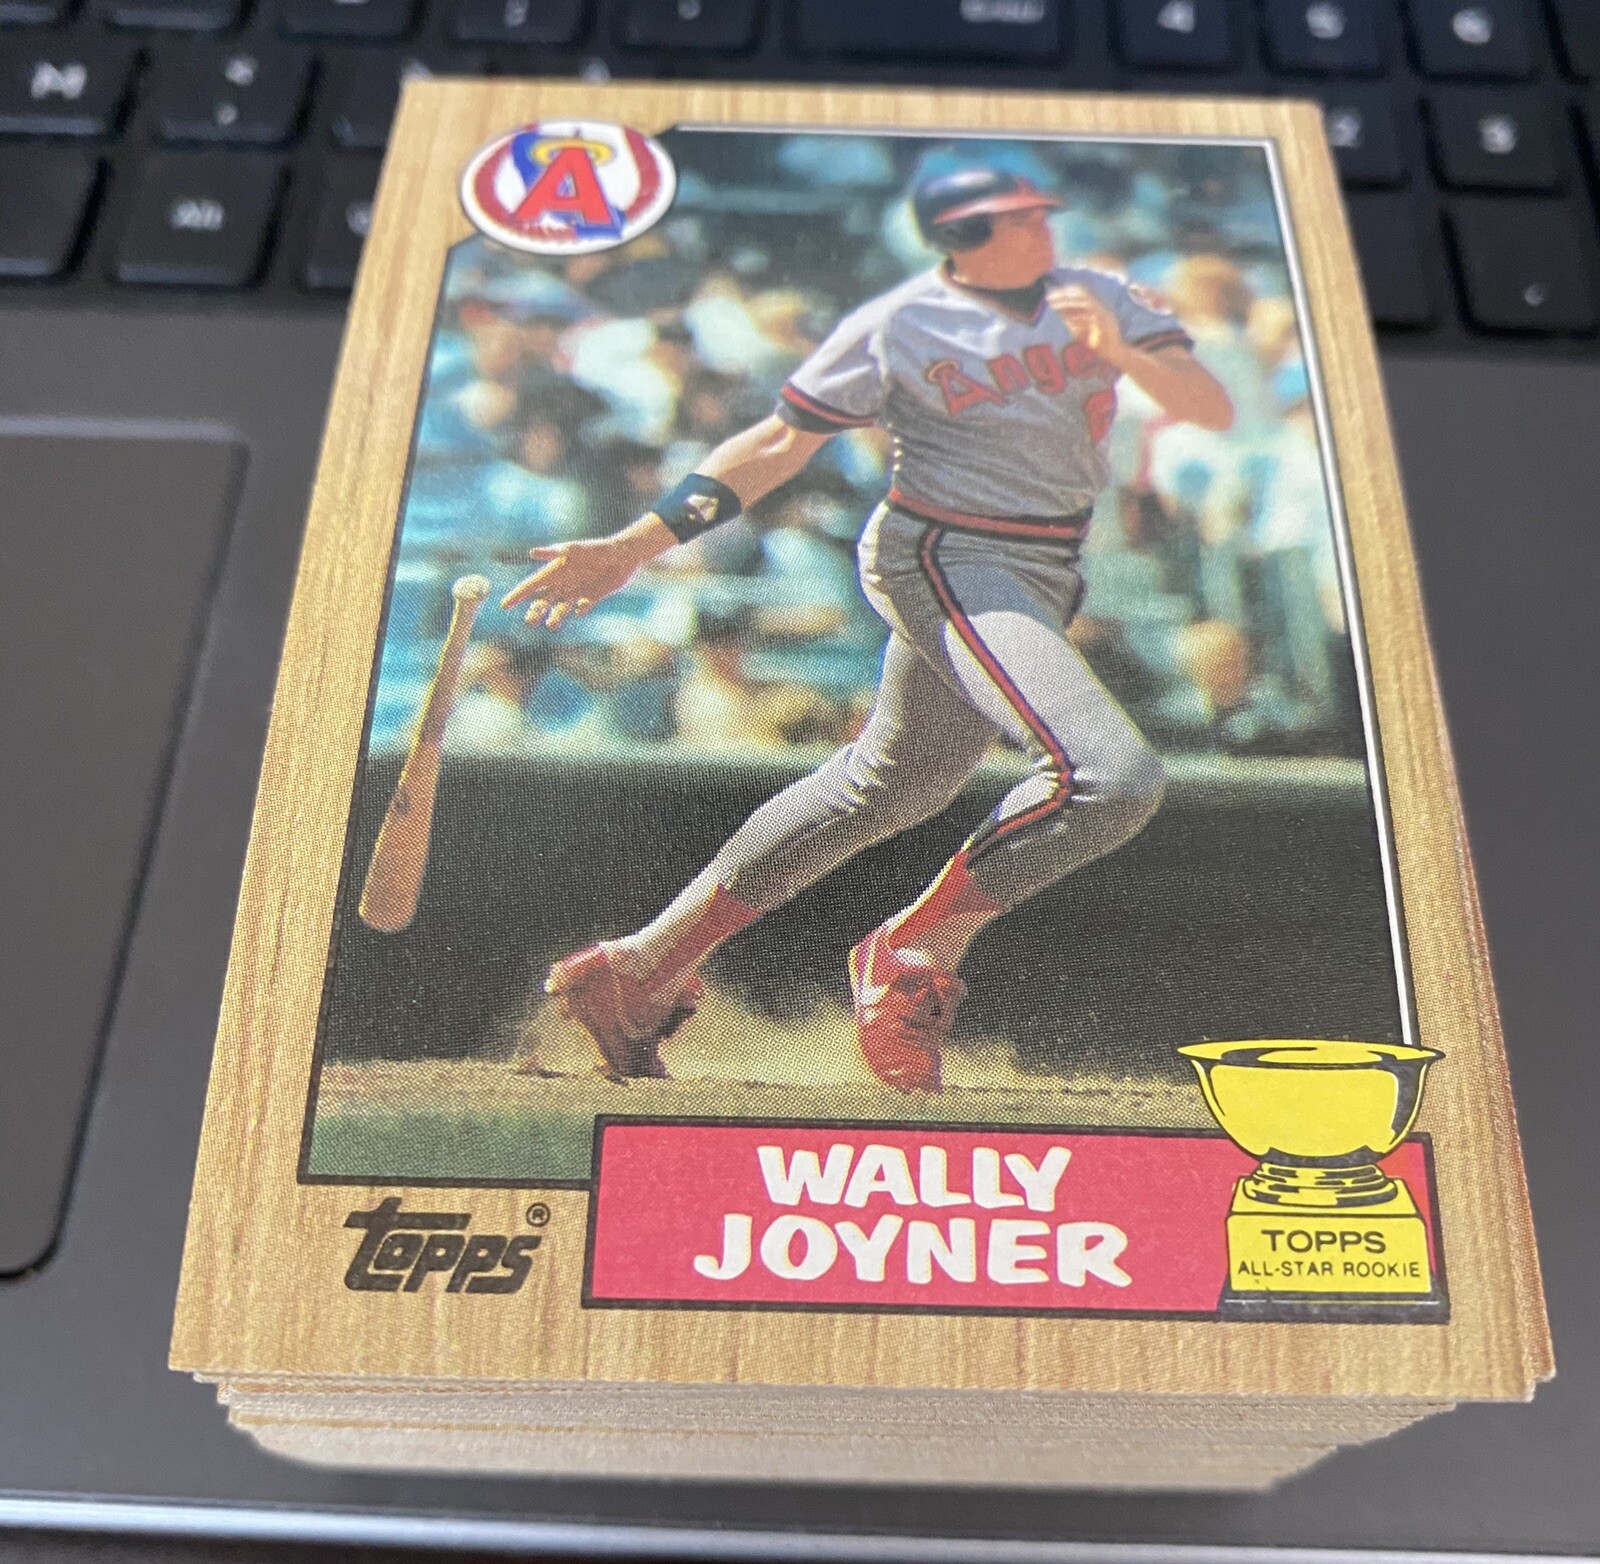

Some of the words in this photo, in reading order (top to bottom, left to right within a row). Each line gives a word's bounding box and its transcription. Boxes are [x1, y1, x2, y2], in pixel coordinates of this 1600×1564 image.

[31, 62, 87, 99] M
[515, 146, 613, 224] A
[925, 340, 1100, 416] Ange
[757, 1144, 1071, 1212] WALLY
[693, 1213, 1133, 1287] JOYNER
[1238, 1260, 1333, 1277] ALL-STAR
[1343, 1261, 1421, 1278] ROOKIE
[1261, 1229, 1387, 1254] TOPPS
